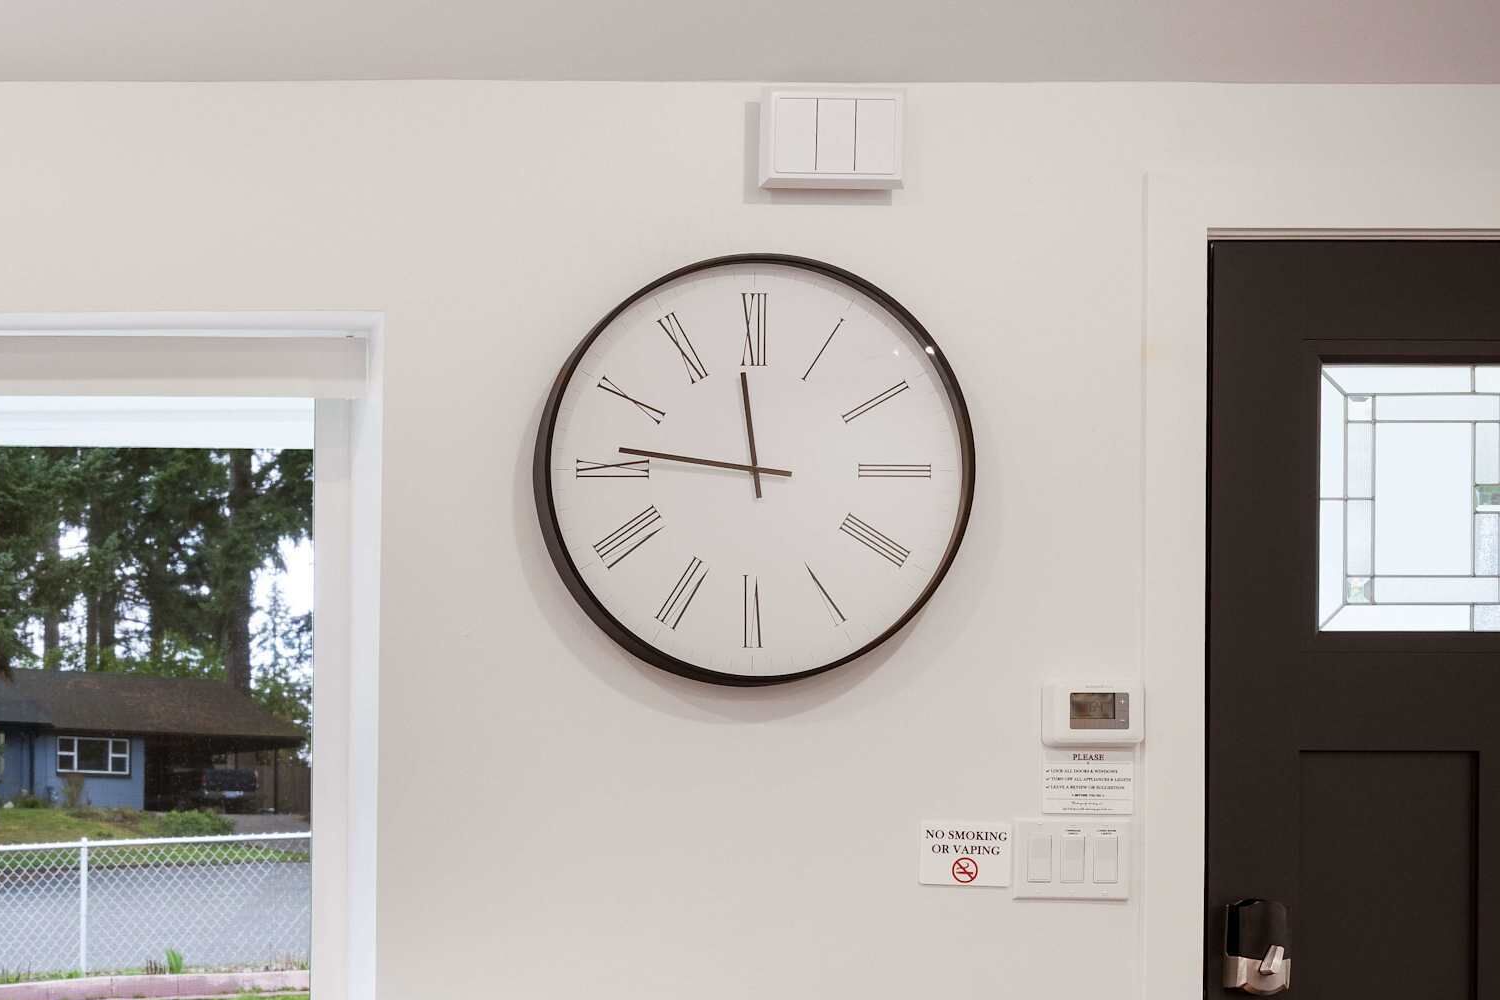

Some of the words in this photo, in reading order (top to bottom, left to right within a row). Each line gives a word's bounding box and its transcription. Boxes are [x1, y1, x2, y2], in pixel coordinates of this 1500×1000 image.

[740, 292, 768, 366] XII
[657, 312, 710, 384] XI
[596, 375, 666, 424] X
[576, 459, 649, 479] IX
[804, 561, 847, 626] V
[1072, 753, 1105, 761] PLEASE
[925, 829, 945, 839] NO
[947, 830, 1008, 841] SMOKING
[931, 844, 949, 854] OR
[953, 845, 1001, 856] VAPING
